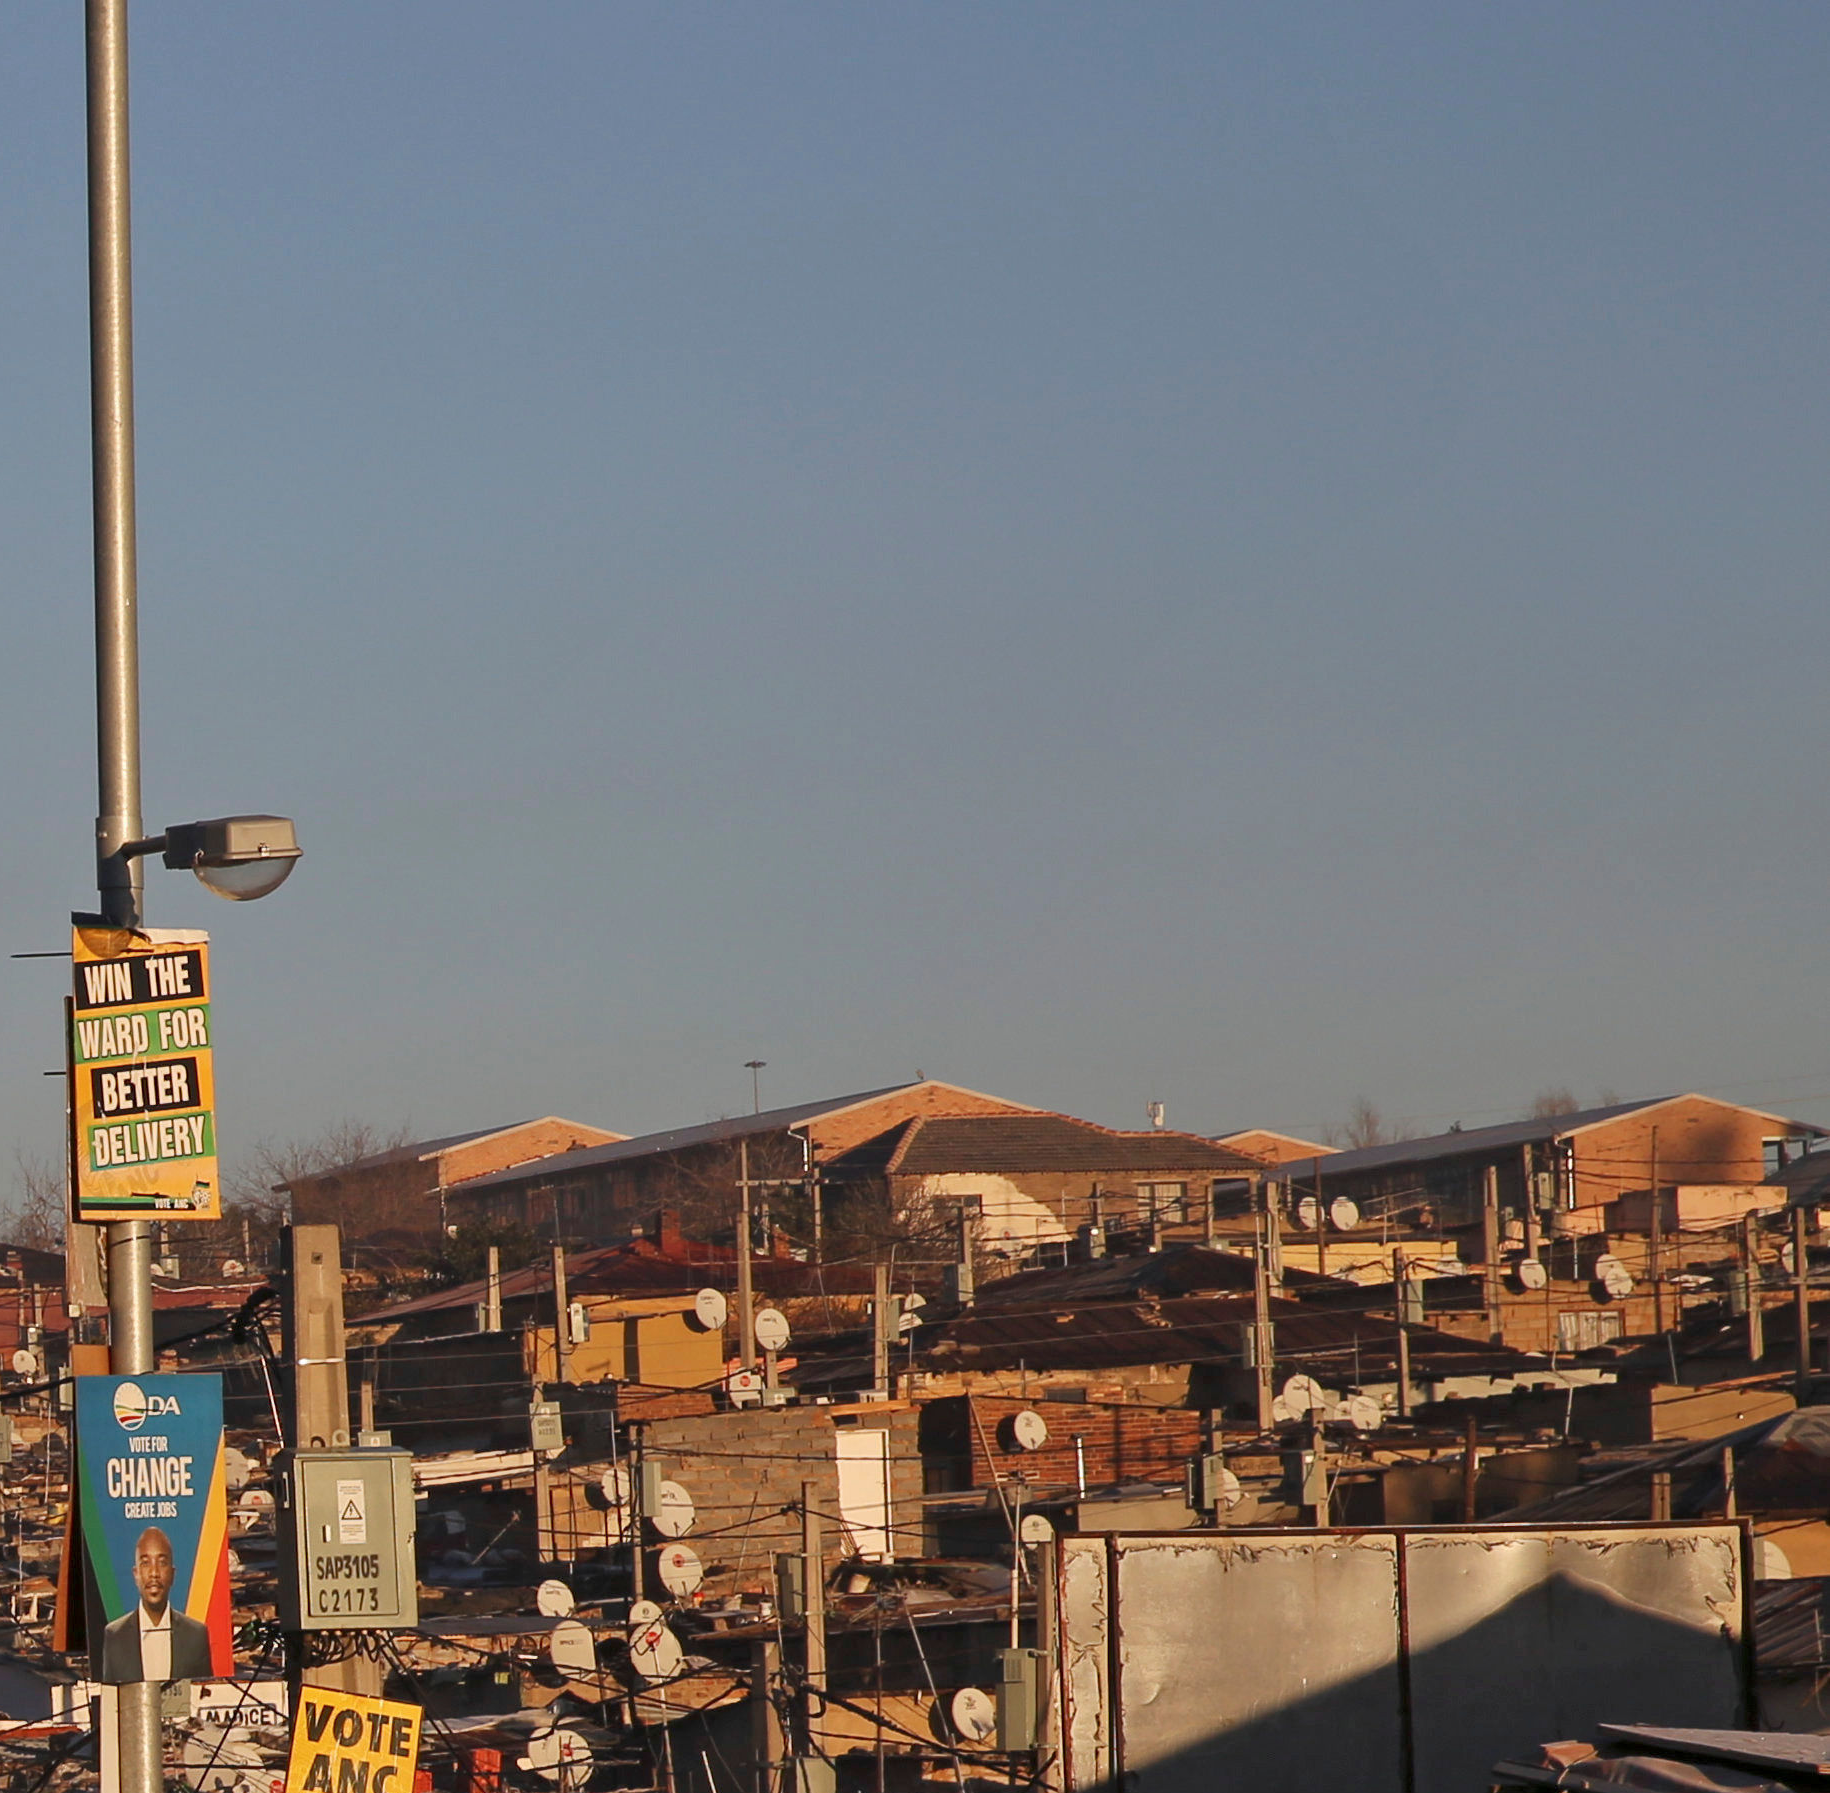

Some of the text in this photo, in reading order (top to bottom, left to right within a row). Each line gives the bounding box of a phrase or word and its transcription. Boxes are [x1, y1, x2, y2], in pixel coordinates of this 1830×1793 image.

[84, 954, 192, 1005] WIN THE
[78, 1007, 208, 1061] WARD FOR
[101, 1063, 190, 1113] BETTER
[93, 1114, 206, 1168] DELIVERY
[155, 1198, 189, 1209] VOTE ANC
[147, 1395, 181, 1416] DA
[129, 1435, 169, 1453] VOTE FOR
[107, 1456, 194, 1499] CHANGE
[125, 1501, 178, 1519] CREATE JOBS
[316, 1554, 380, 1581] SAP3105
[319, 1587, 379, 1613] C2173
[305, 1702, 413, 1758] VOTE
